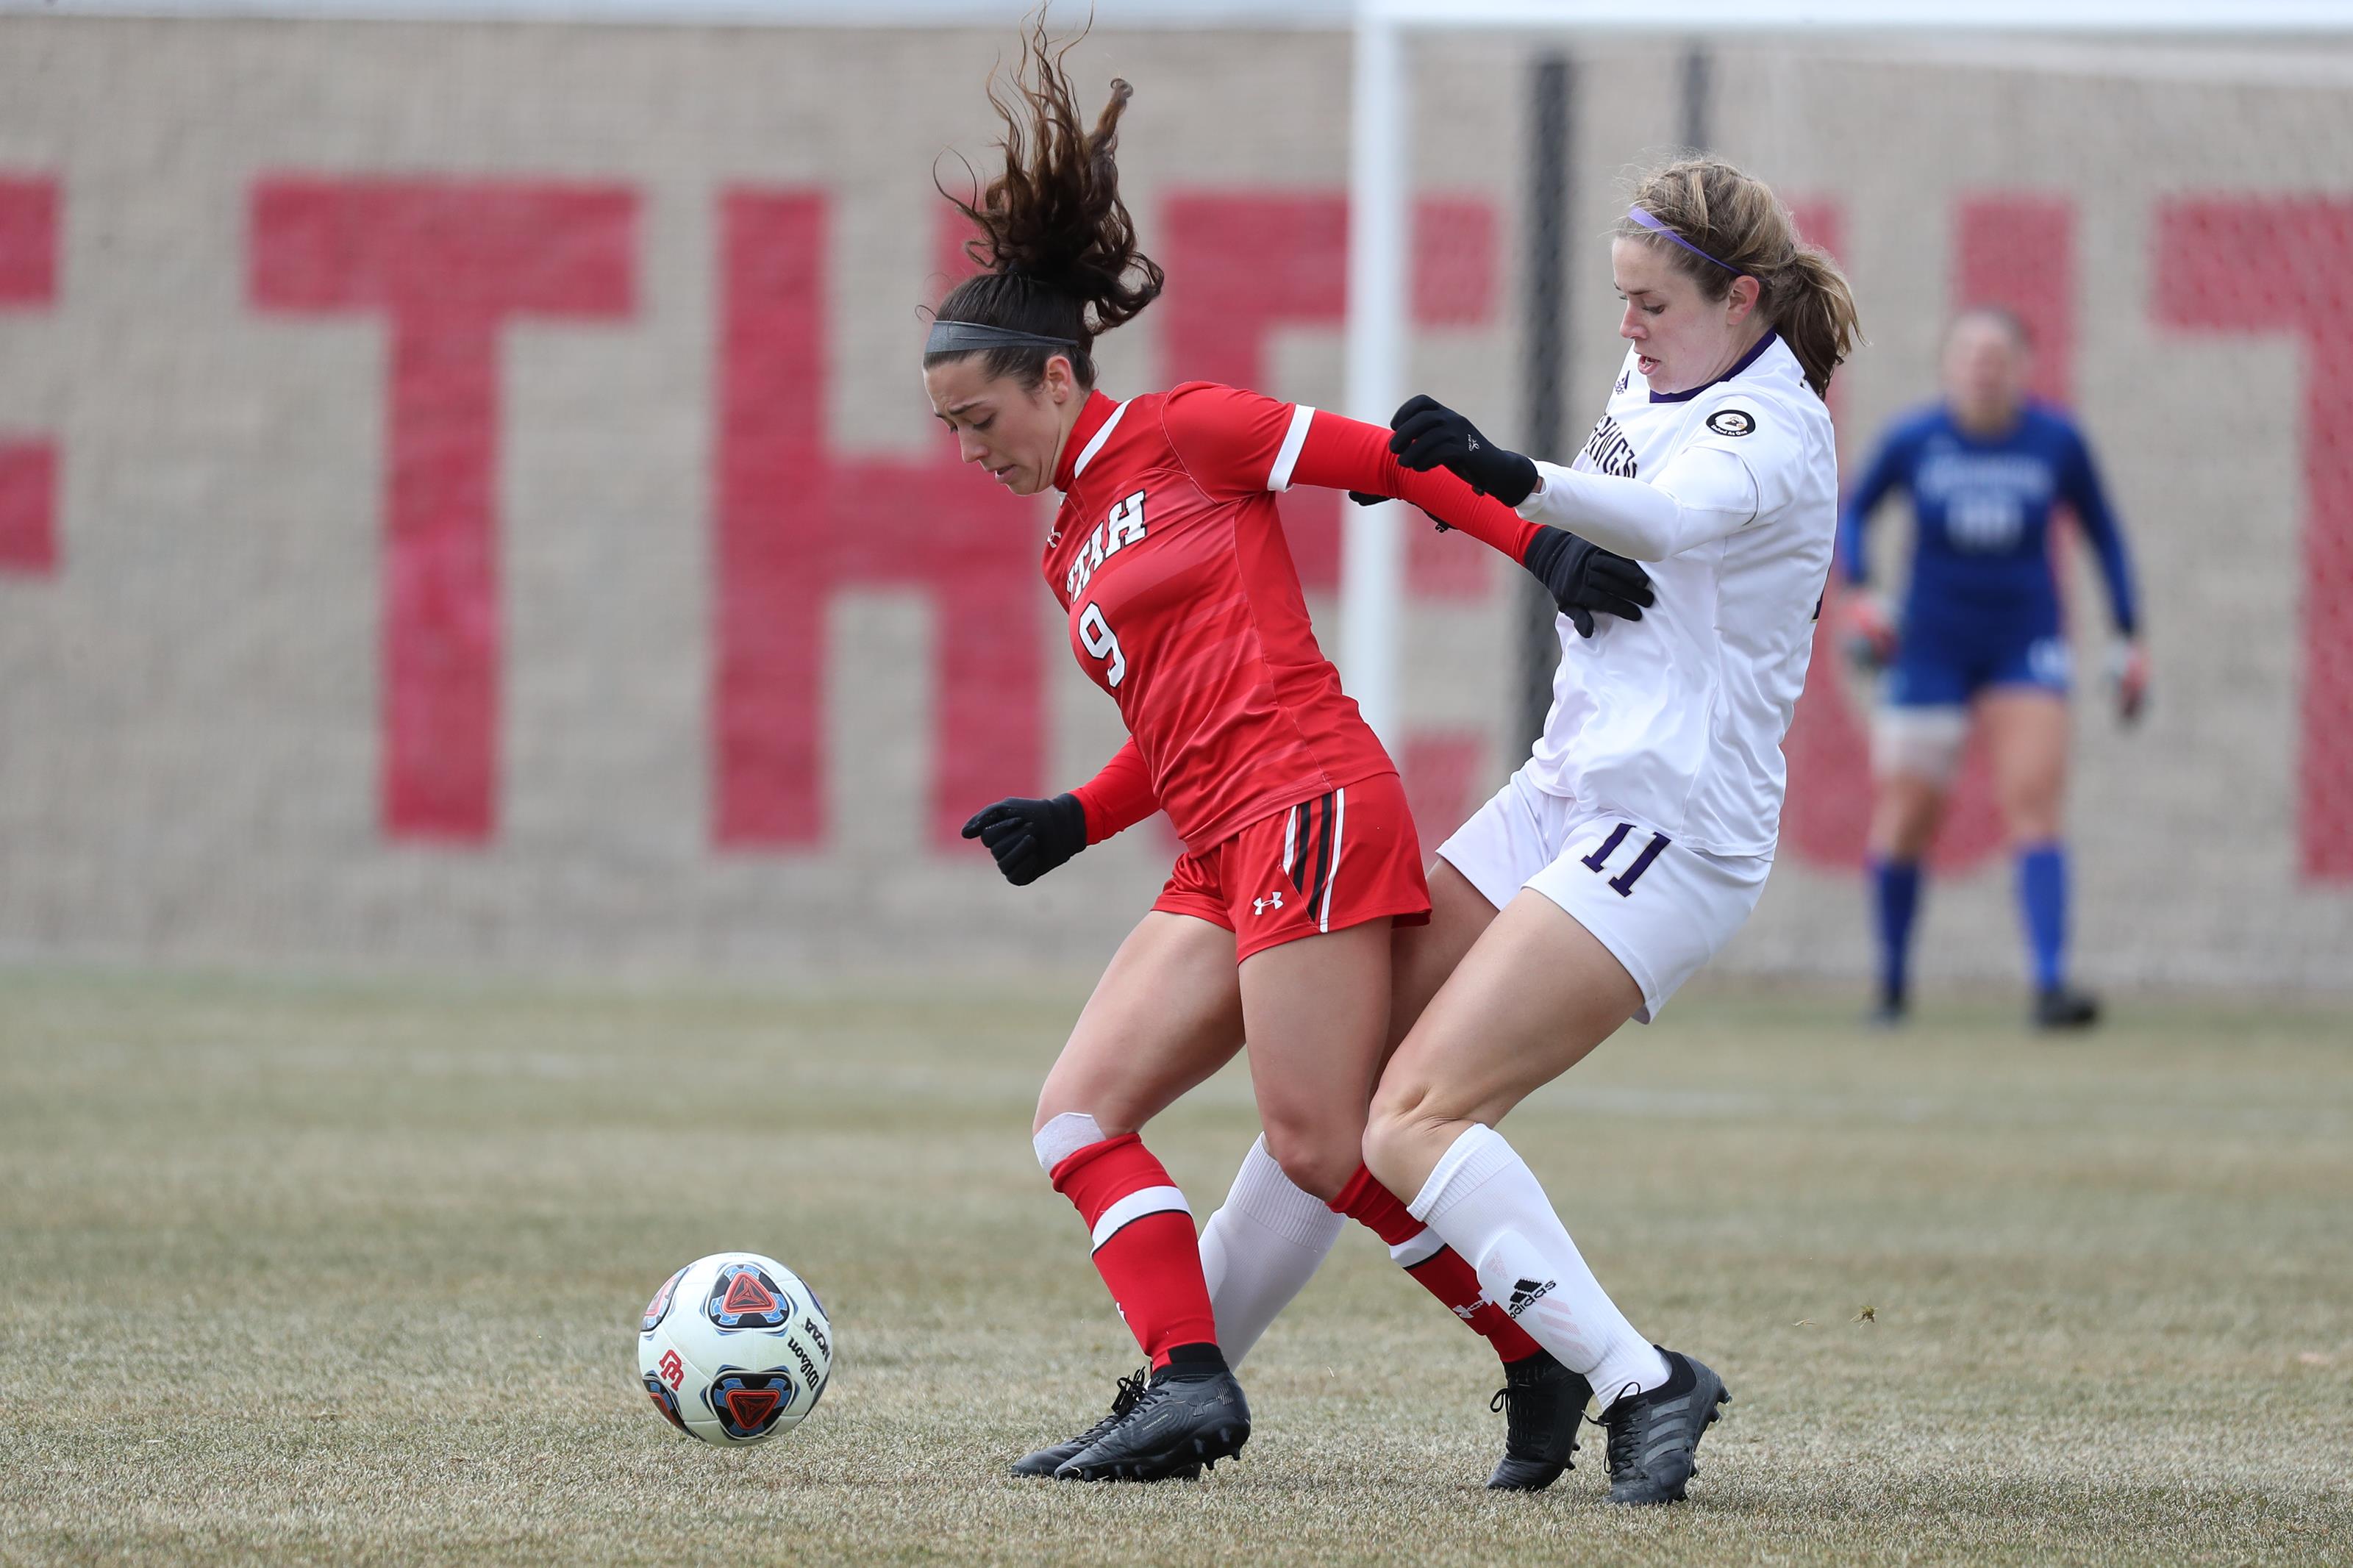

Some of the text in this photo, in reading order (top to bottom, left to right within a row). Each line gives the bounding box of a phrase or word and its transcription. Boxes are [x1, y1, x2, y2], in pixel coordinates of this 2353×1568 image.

[245, 175, 1496, 854] THE
[1078, 600, 1126, 688] 9
[1580, 821, 1672, 898] 11
[1509, 1280, 1557, 1320] adidas
[788, 1334, 820, 1392] Wilson
[804, 1316, 830, 1363] NCAA
